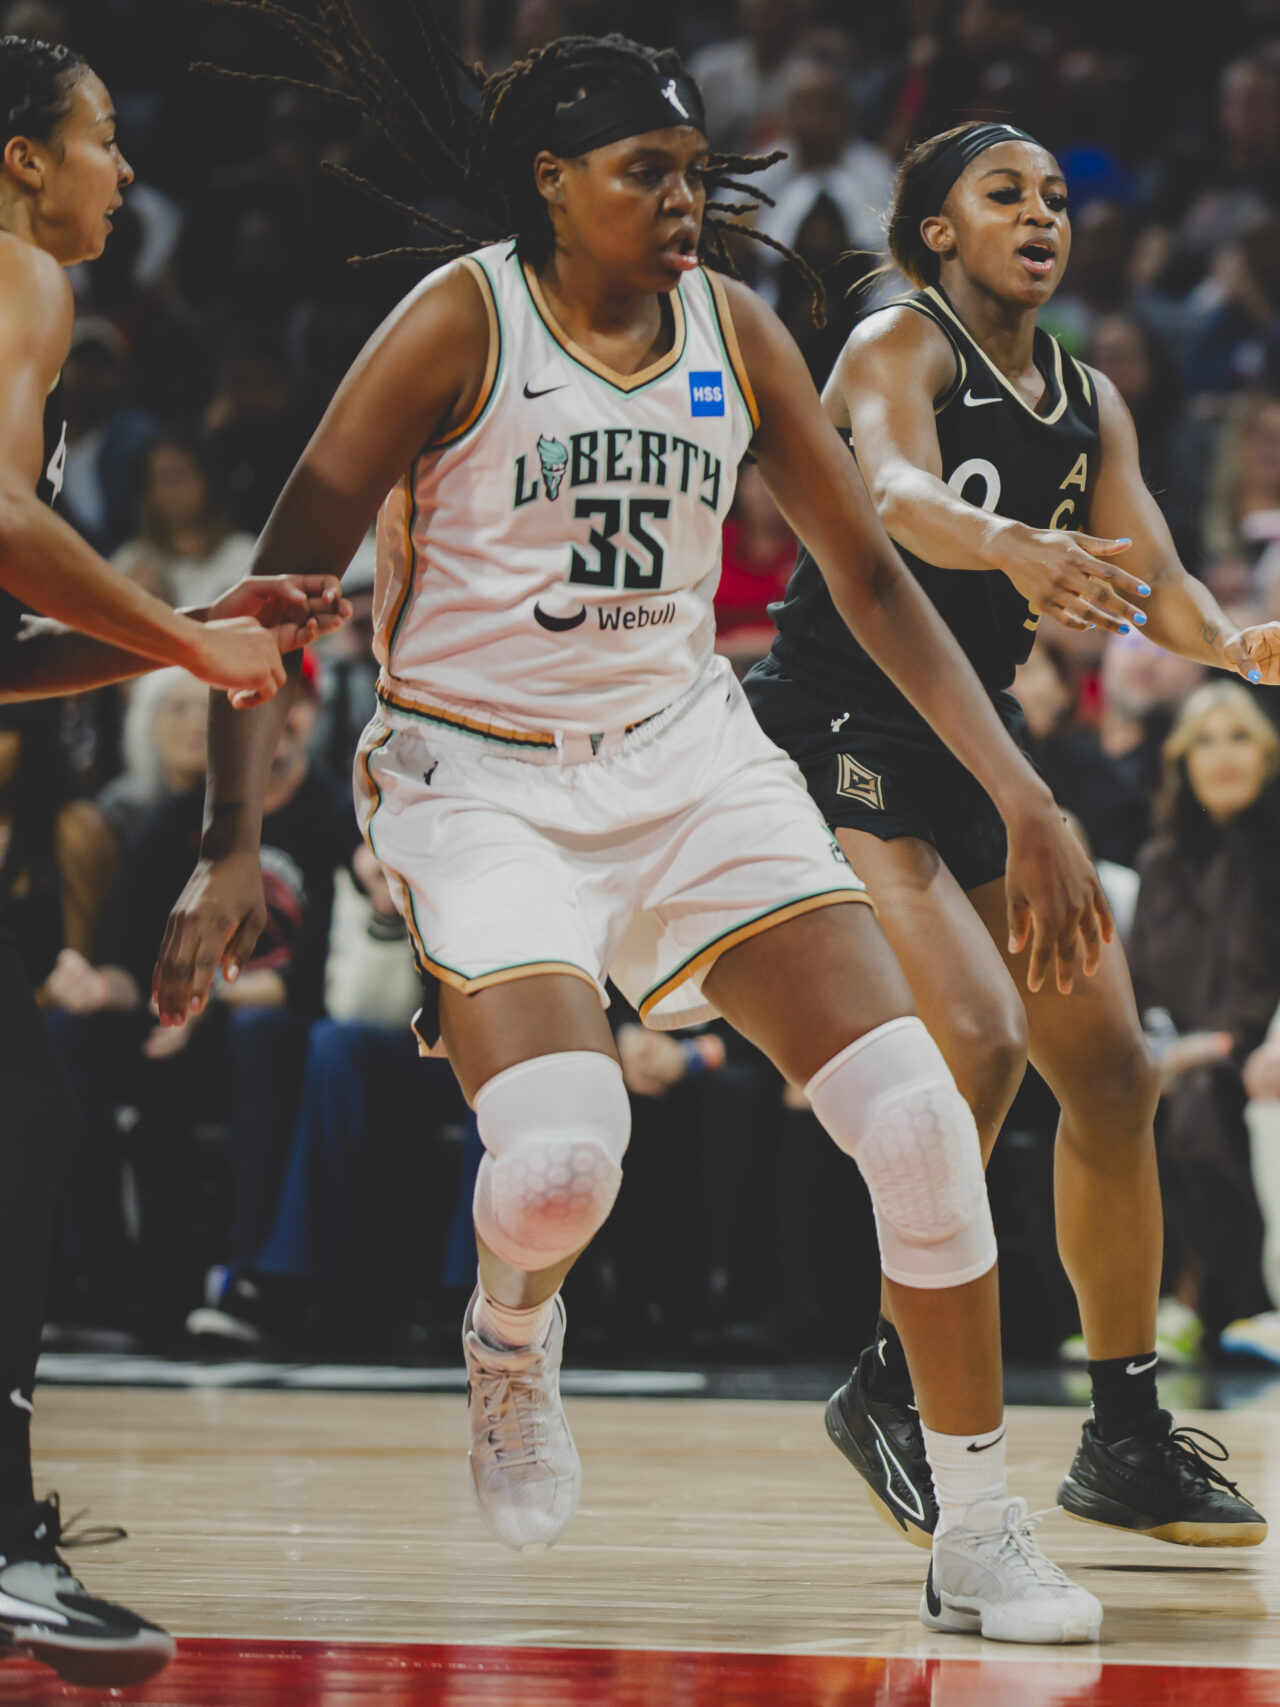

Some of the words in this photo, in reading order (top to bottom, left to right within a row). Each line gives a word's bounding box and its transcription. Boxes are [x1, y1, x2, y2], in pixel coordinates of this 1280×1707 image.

[693, 387, 722, 402] HSS
[569, 499, 670, 589] 35
[598, 602, 675, 630] Webull
